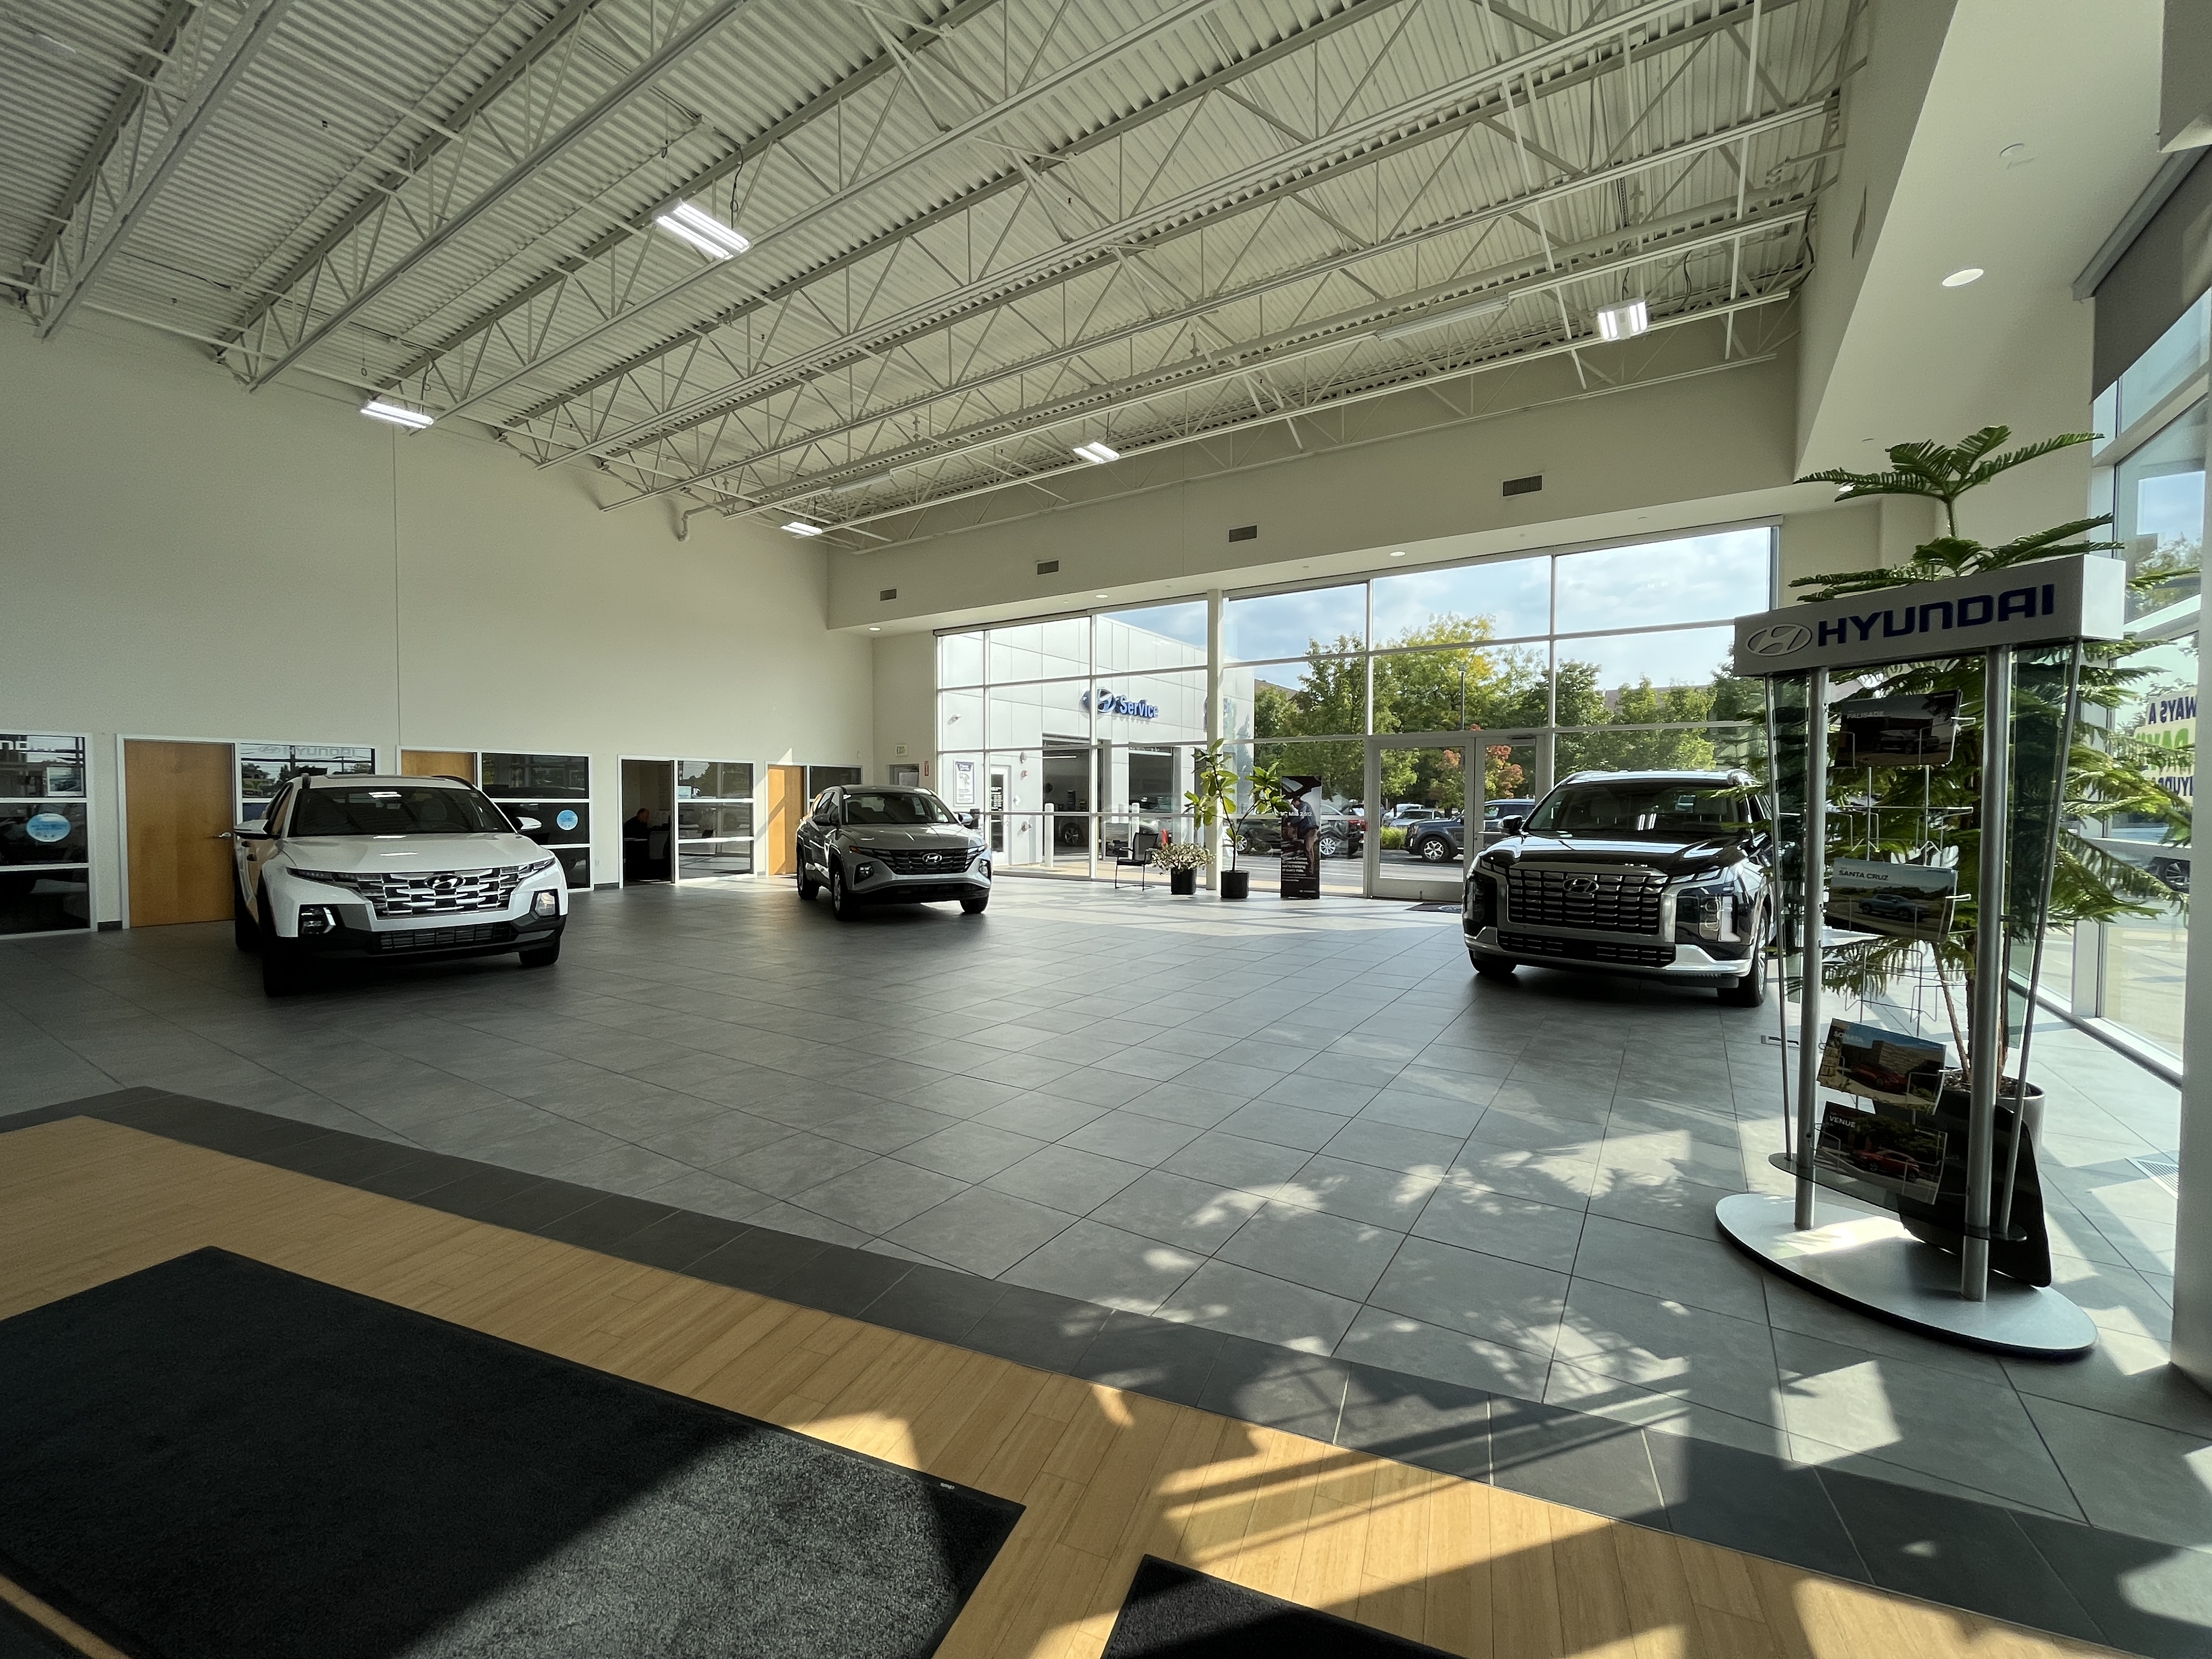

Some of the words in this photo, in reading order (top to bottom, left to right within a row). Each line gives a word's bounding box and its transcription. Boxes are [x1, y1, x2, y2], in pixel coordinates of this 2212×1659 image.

[1818, 583, 2055, 647] HYUNDAI
[1120, 695, 1159, 718] Service
[1838, 870, 1865, 878] SANTA
[1833, 1030, 1864, 1043] SONATA
[1829, 1115, 1857, 1128] VENUE
